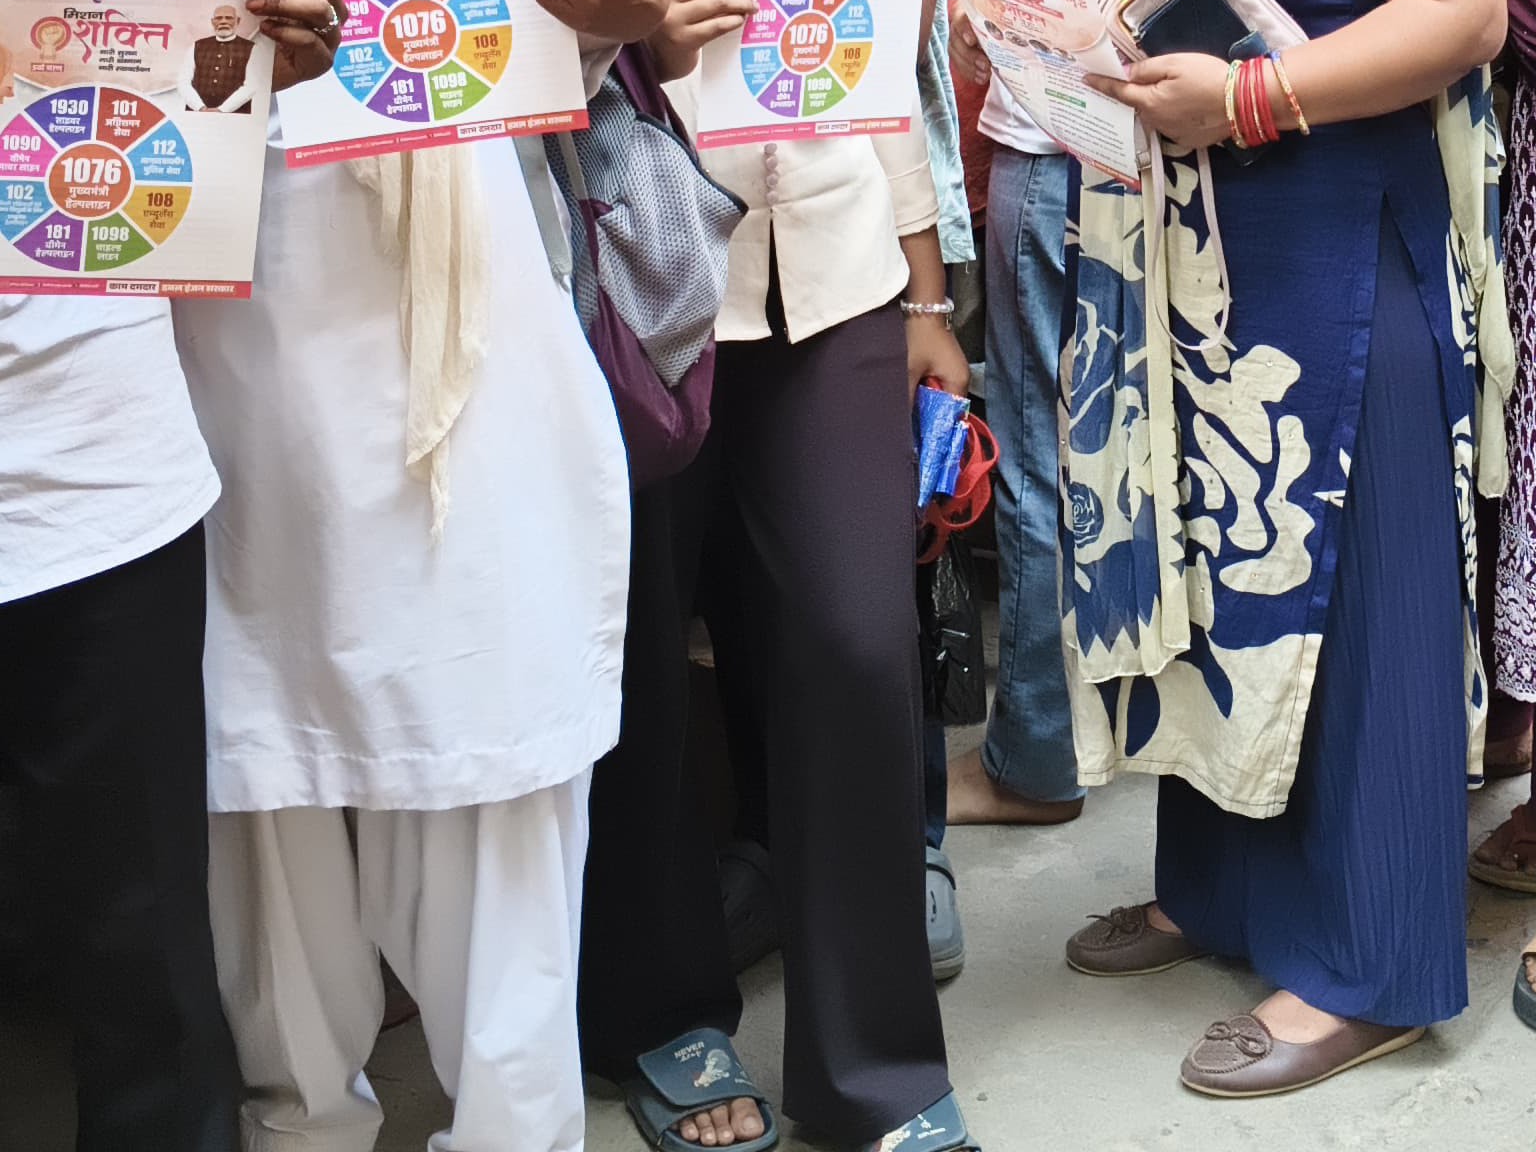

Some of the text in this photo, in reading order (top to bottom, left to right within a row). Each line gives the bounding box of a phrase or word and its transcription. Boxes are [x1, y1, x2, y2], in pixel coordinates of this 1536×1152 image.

[63, 7, 105, 20] मिशन
[390, 10, 447, 39] 1076
[73, 9, 173, 64] शक्ति
[473, 33, 499, 48] 108
[789, 23, 828, 45] 1076
[347, 47, 373, 63] 102
[432, 72, 468, 90] 1098
[50, 99, 89, 116] 1930
[111, 100, 138, 116] 101
[2, 135, 42, 151] 1090
[152, 140, 176, 155] 112
[61, 157, 121, 184] 1076
[5, 185, 34, 200] 102
[146, 193, 174, 207] 108
[45, 225, 71, 239] 181
[91, 226, 130, 241] 1098
